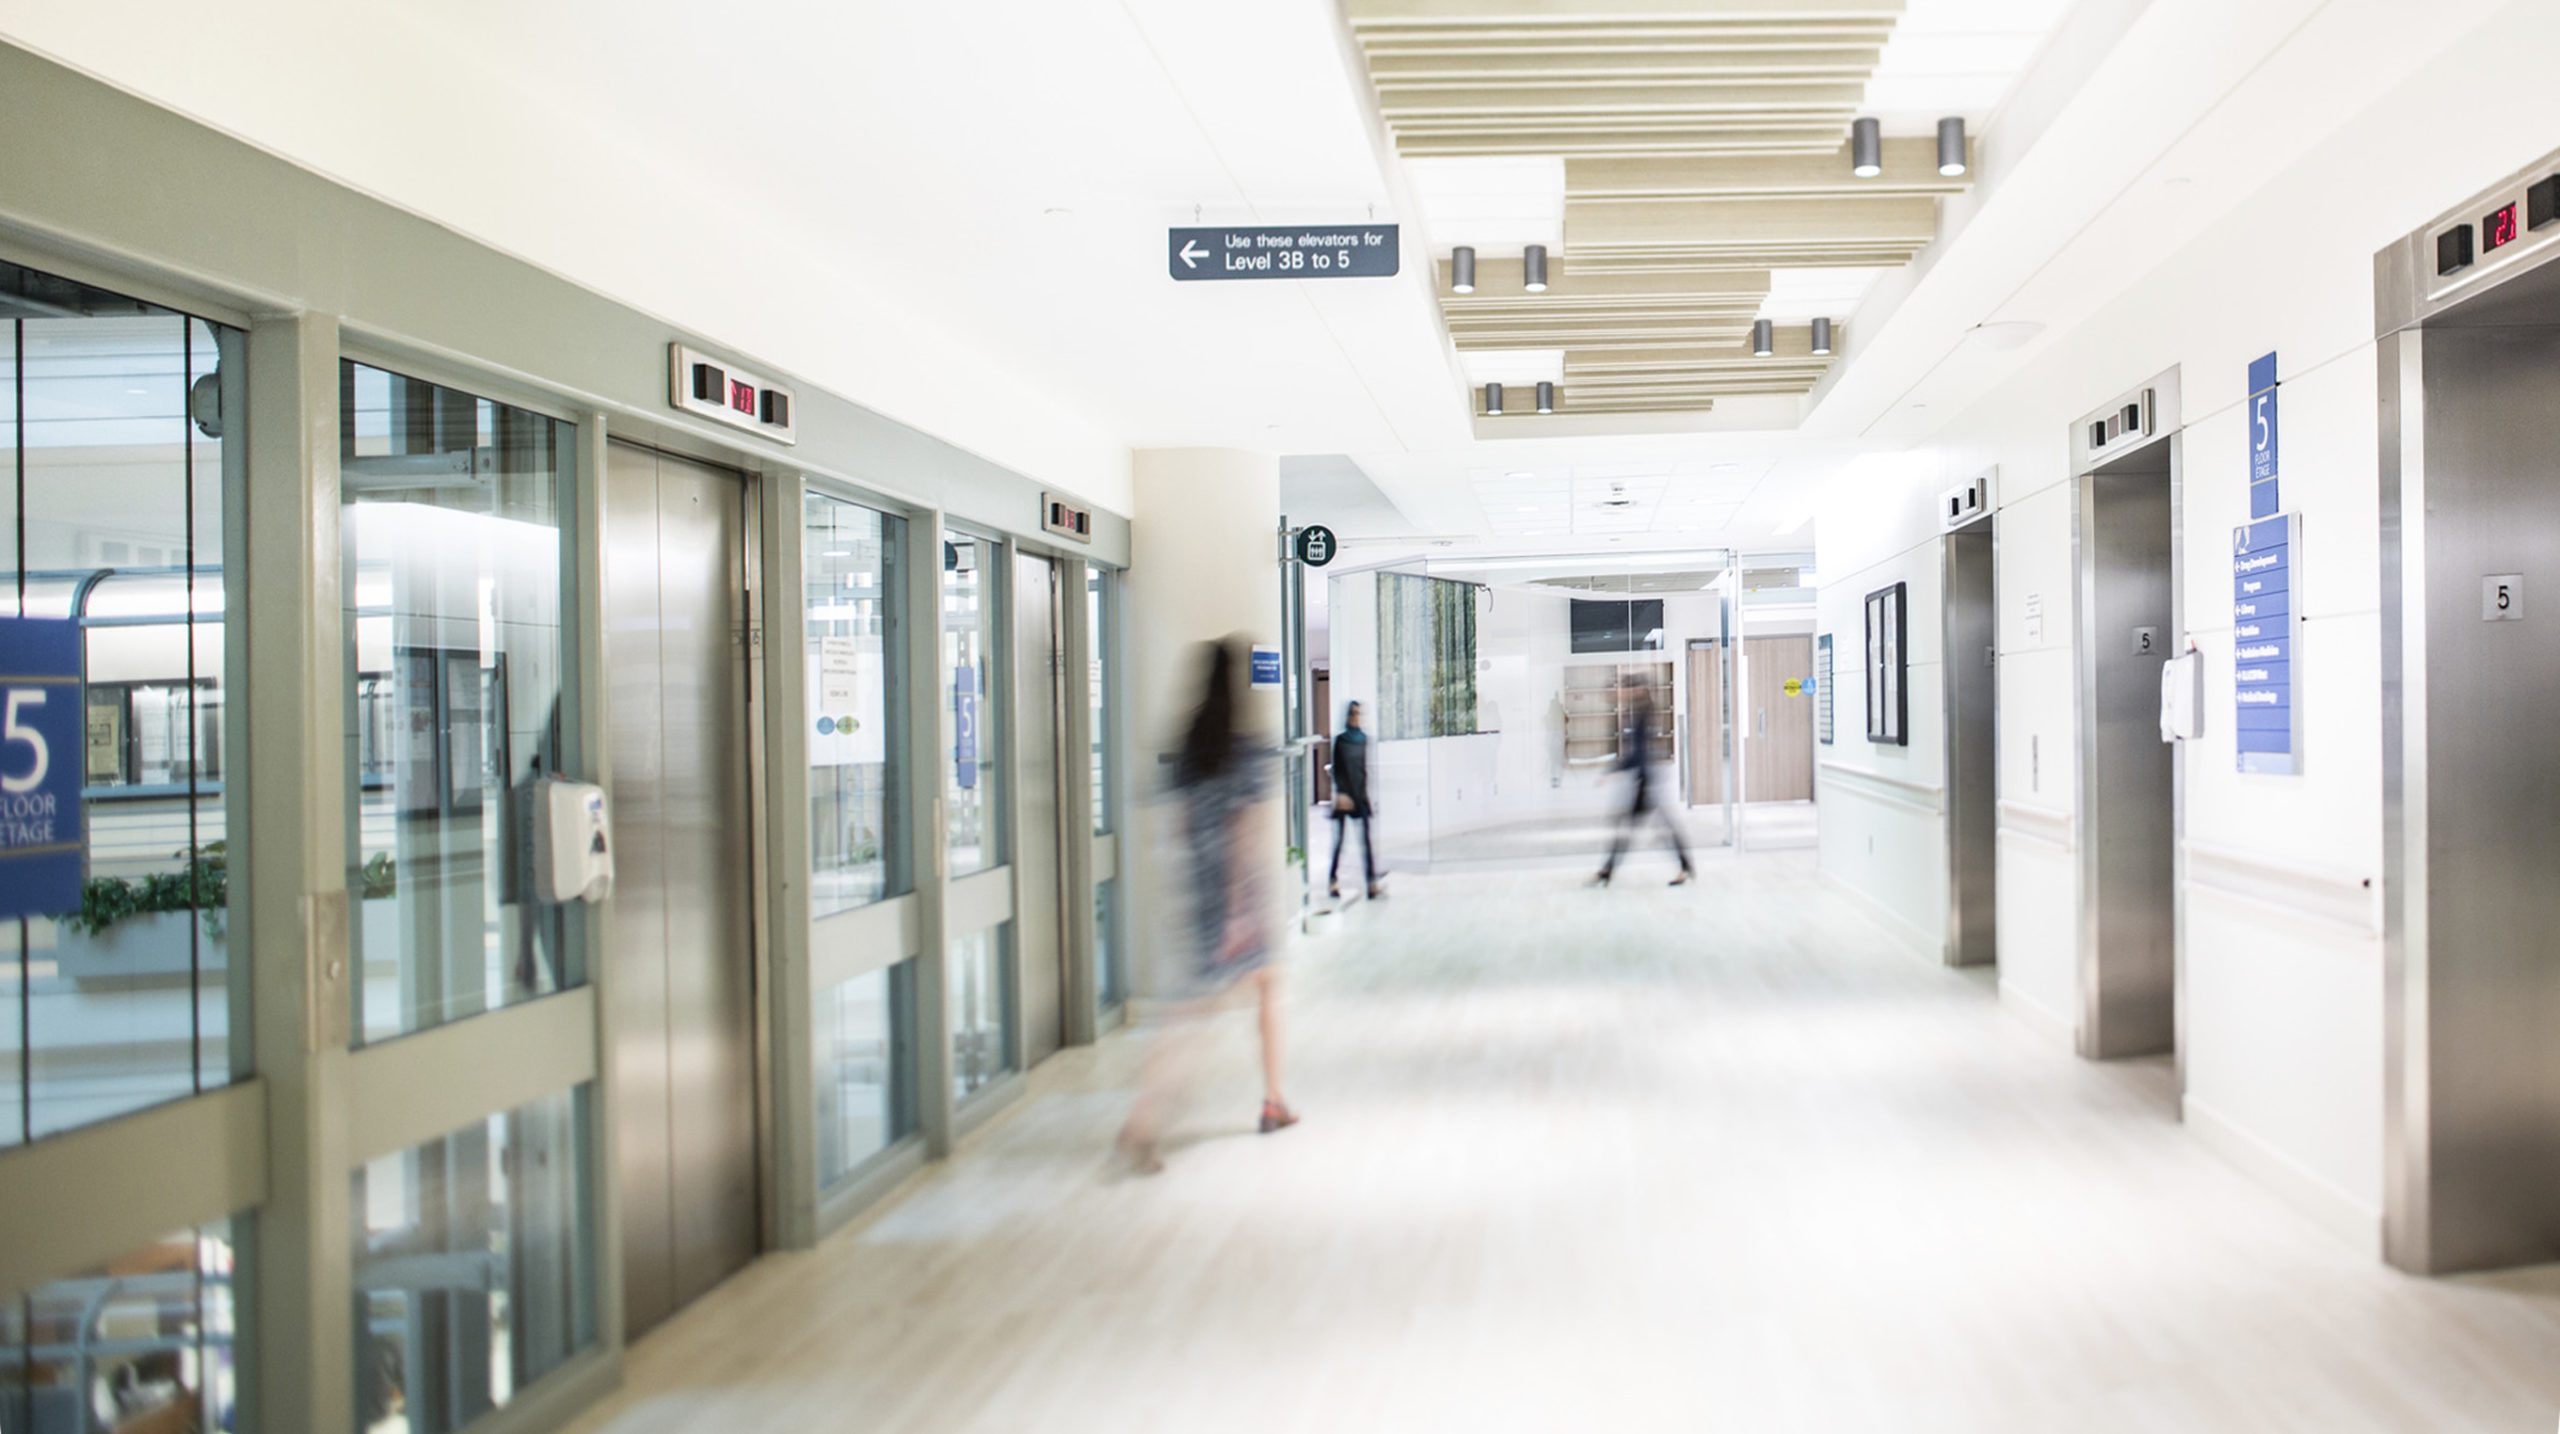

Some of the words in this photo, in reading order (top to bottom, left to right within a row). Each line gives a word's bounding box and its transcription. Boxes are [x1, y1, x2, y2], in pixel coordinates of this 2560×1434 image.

[1225, 234, 1251, 248] Use
[1257, 233, 1293, 248] these
[1298, 232, 1359, 247] elevators
[1364, 231, 1383, 246] for
[1225, 252, 1271, 271] Level
[1278, 251, 1304, 269] 3B
[1312, 251, 1331, 268] to
[1337, 250, 1350, 268] 5
[2256, 396, 2268, 451] 5
[2255, 451, 2270, 465] FLOOR
[2497, 585, 2510, 610] 5
[2142, 633, 2150, 649] 5
[962, 698, 972, 737] 5
[1, 690, 49, 793] 5
